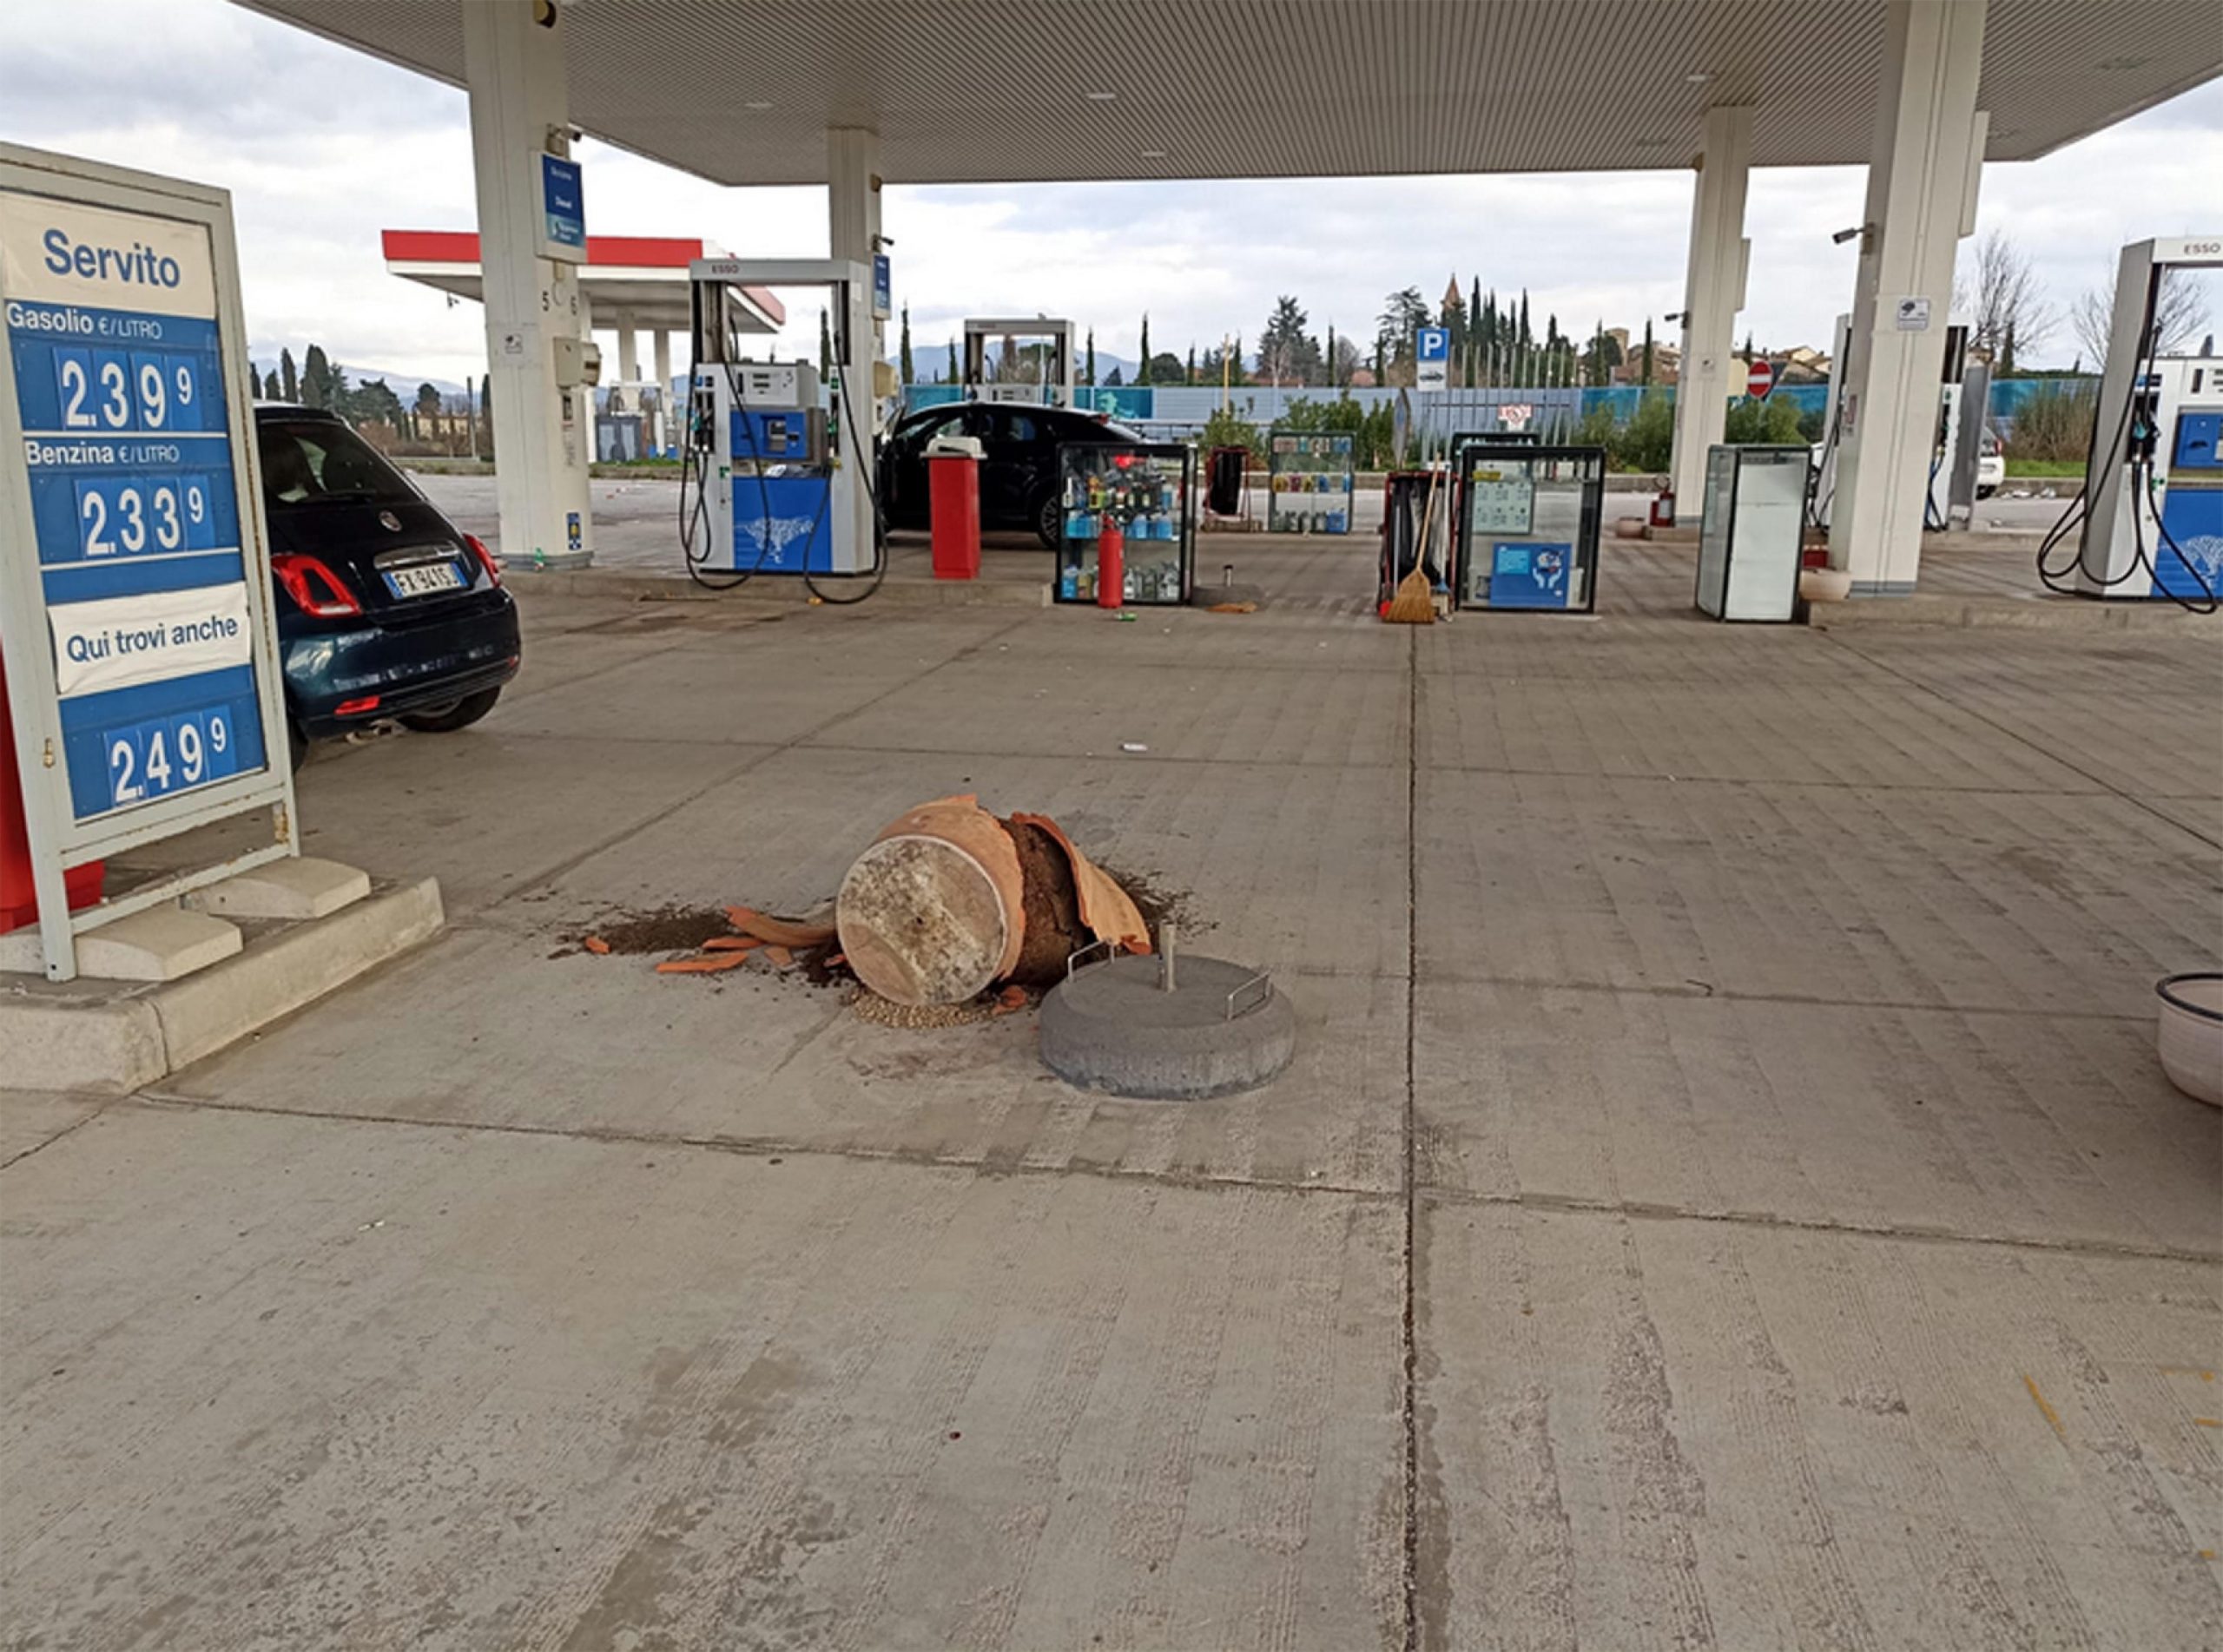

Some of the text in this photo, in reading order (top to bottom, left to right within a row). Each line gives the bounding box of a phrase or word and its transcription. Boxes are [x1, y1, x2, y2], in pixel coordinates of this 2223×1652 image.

[43, 227, 181, 288] Servito
[2183, 242, 2221, 256] ESSO
[711, 264, 740, 275] ESSO
[6, 302, 163, 340] Gasolio €/LITRO
[1424, 332, 1443, 357] P
[176, 365, 194, 405] 9
[24, 440, 181, 465] Benzina €/LITRO
[188, 485, 204, 524] 9
[67, 615, 239, 662] Qui trovi anche
[210, 716, 228, 754] 9
